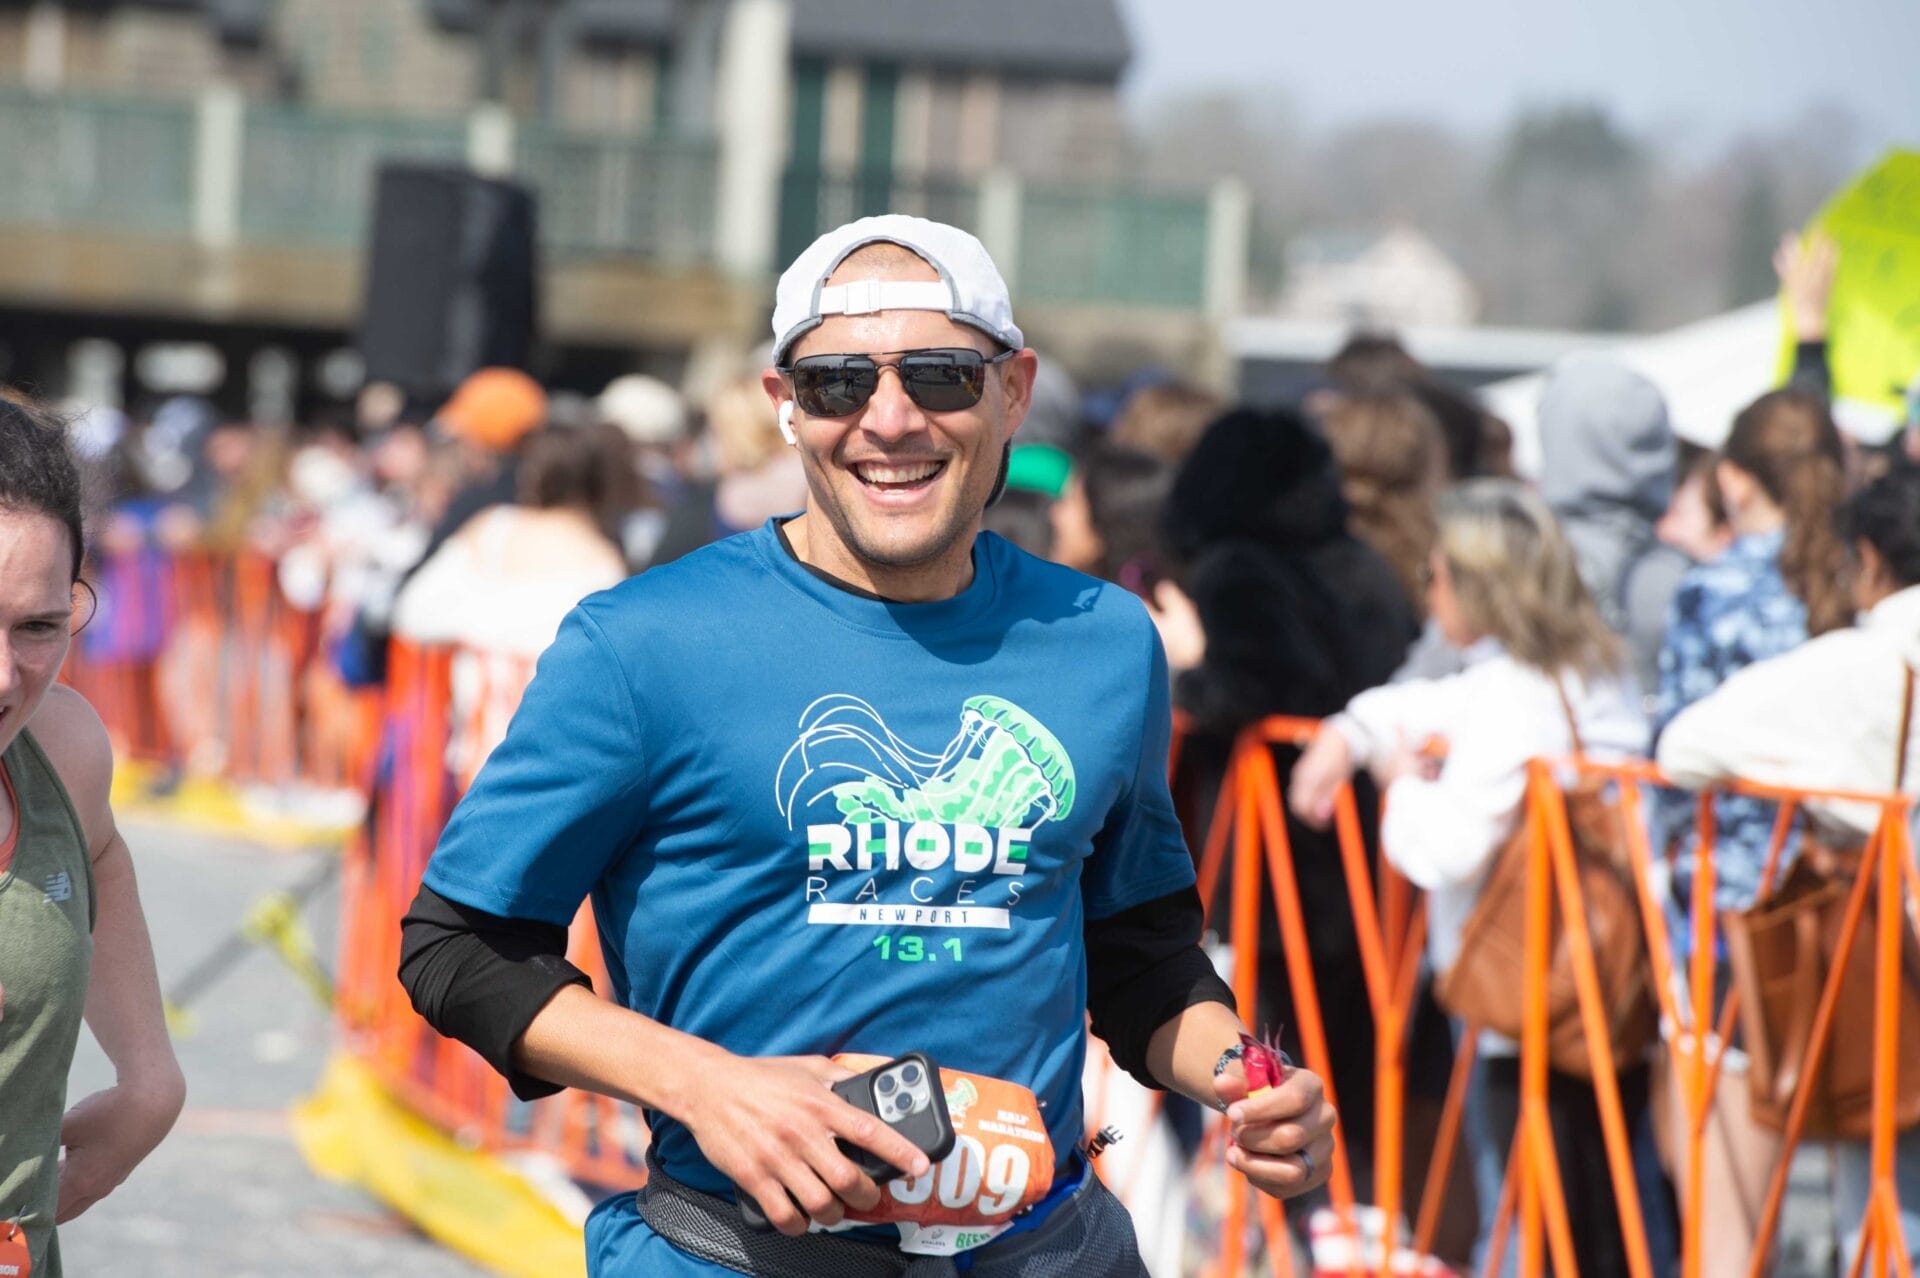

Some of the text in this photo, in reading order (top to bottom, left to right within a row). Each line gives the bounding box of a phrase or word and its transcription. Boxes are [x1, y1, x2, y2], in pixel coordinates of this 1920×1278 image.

[808, 820, 1033, 875] RHODE
[806, 876, 1025, 906] RACES
[859, 908, 969, 924] NEWPORT
[872, 934, 963, 962] 13.1
[997, 1109, 1029, 1126] HALF
[978, 1119, 1046, 1143] MARATHON
